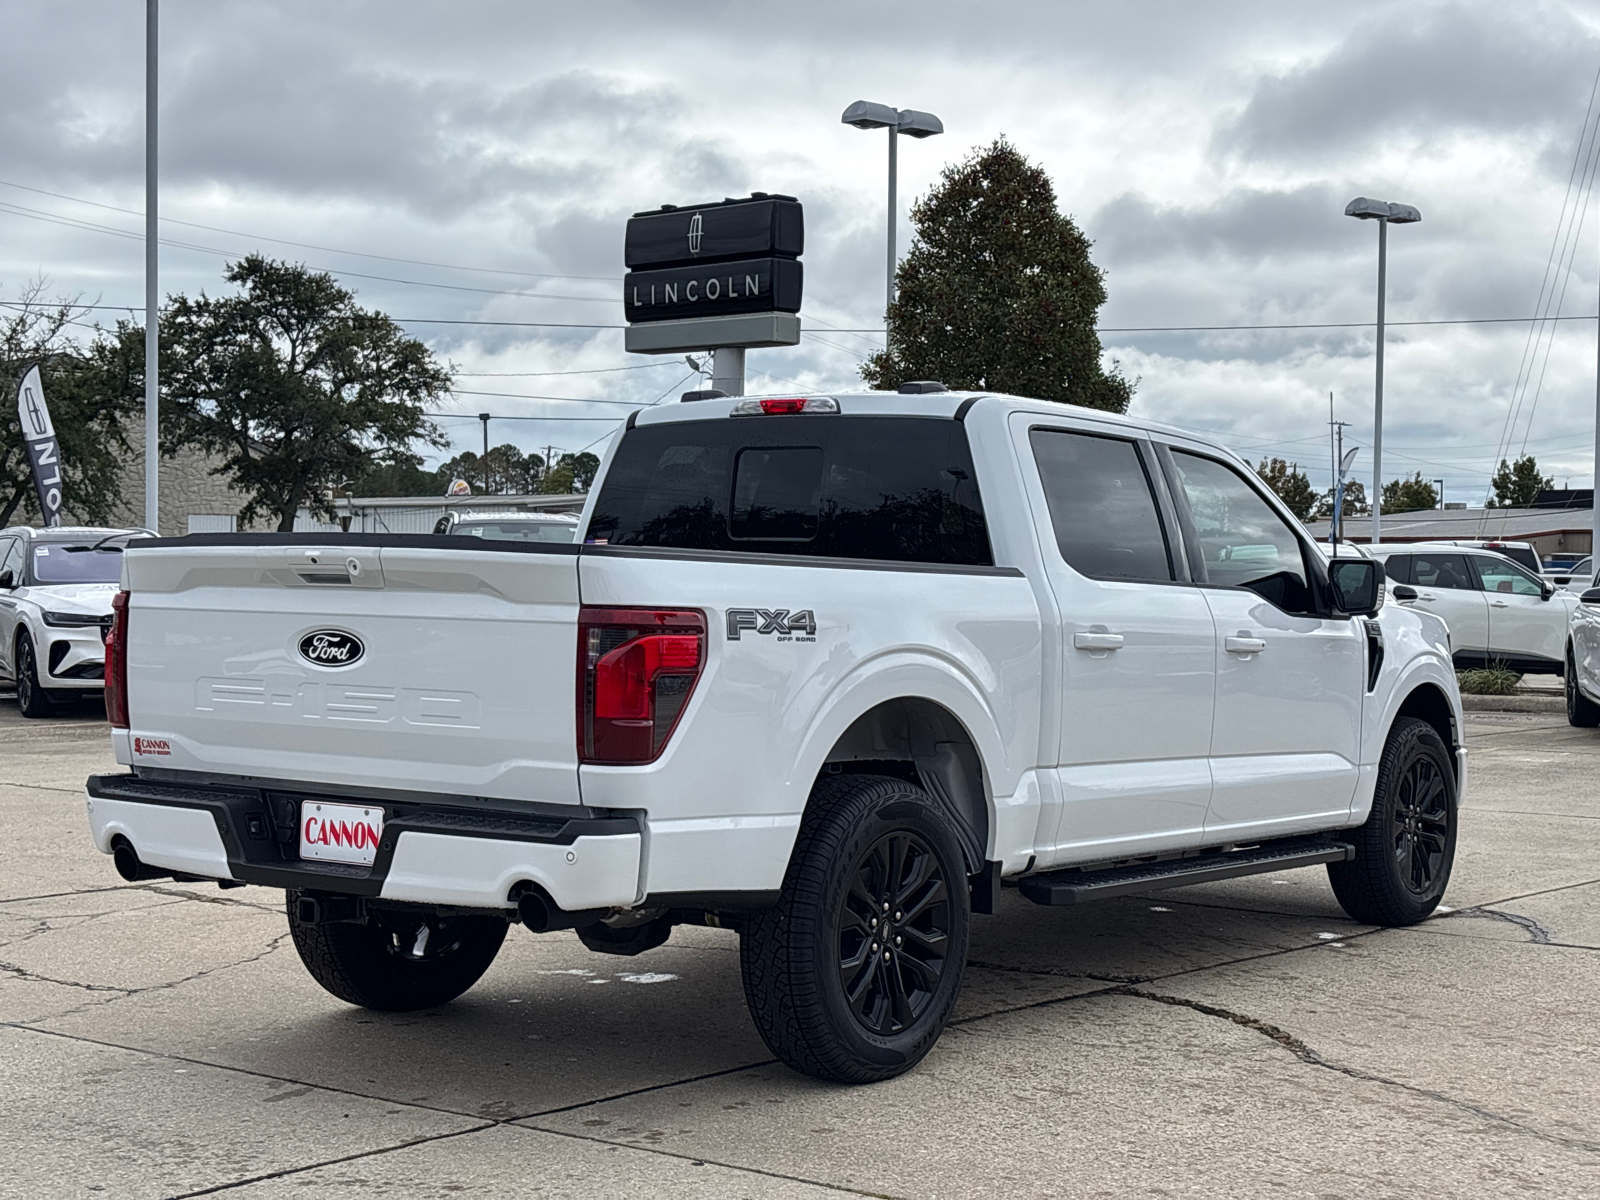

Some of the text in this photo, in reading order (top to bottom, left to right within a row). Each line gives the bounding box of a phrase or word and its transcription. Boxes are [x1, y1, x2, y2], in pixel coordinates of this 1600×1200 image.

[633, 274, 760, 307] LINCOLN
[725, 607, 817, 641] FX4
[308, 634, 351, 660] Ford
[195, 676, 481, 729] F-150
[141, 739, 170, 750] CANNON
[305, 817, 380, 850] CANNON
